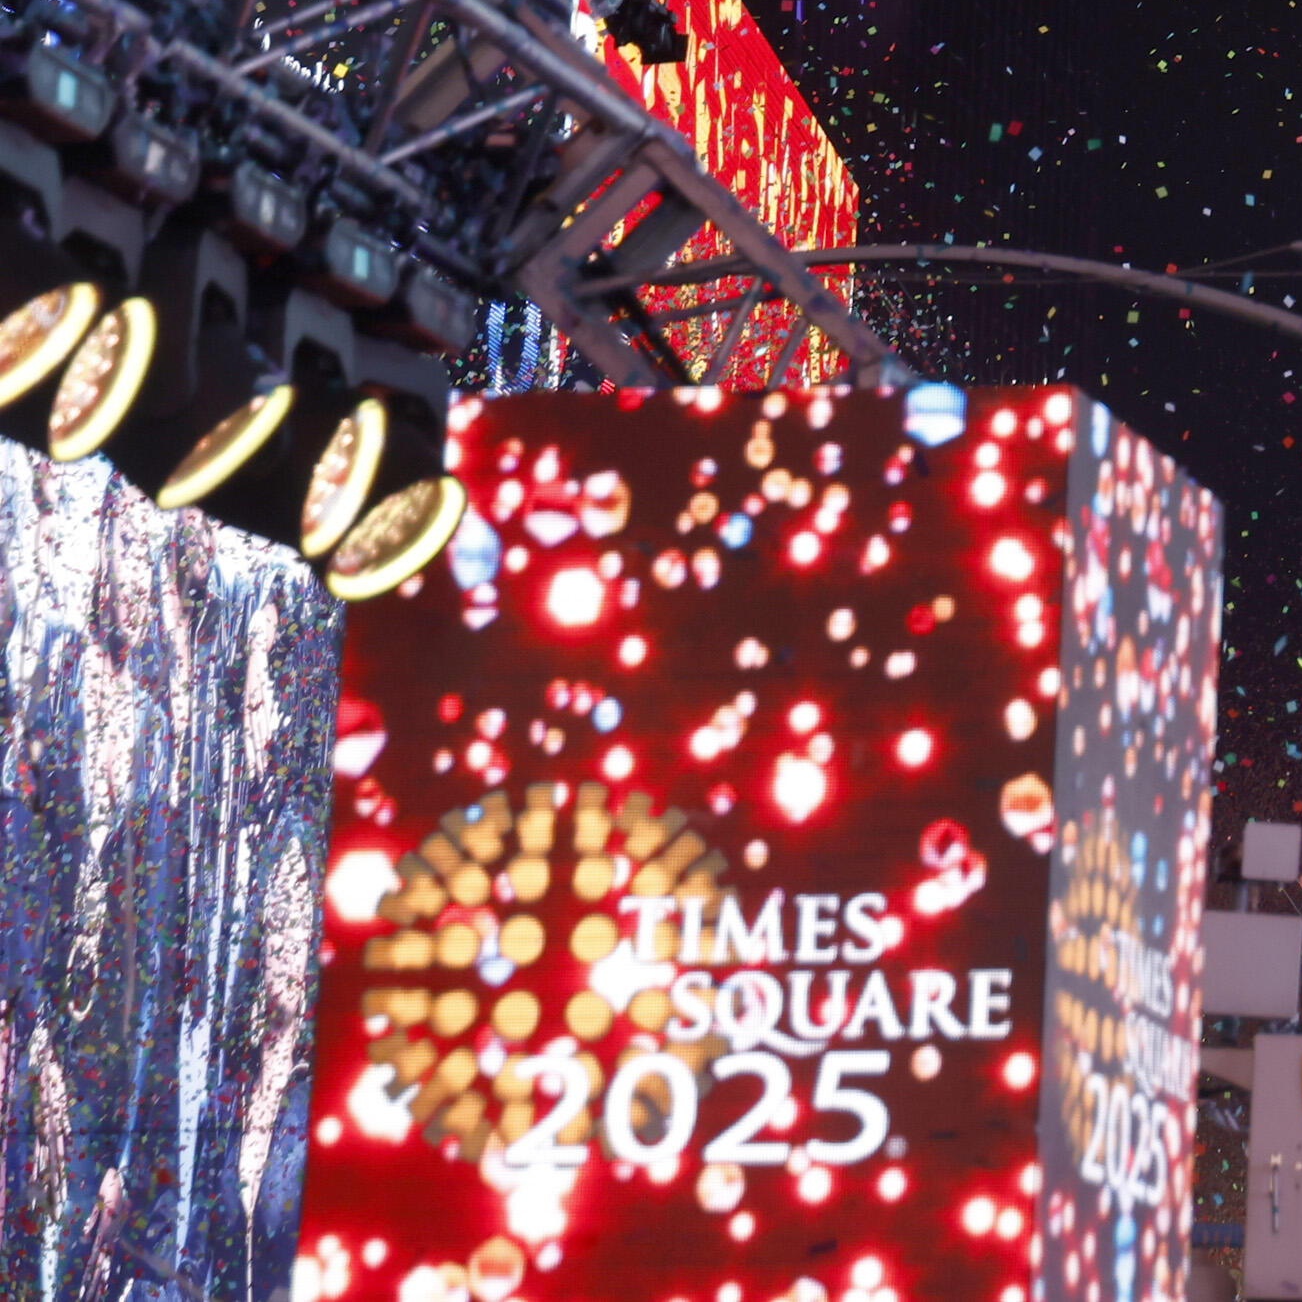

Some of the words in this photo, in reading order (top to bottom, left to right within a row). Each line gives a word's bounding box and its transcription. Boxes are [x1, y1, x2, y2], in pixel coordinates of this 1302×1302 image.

[620, 892, 888, 966] TIMES
[665, 968, 1014, 1058] SQUARE
[504, 1048, 892, 1165] 2025
[1081, 1072, 1168, 1206] 2025
